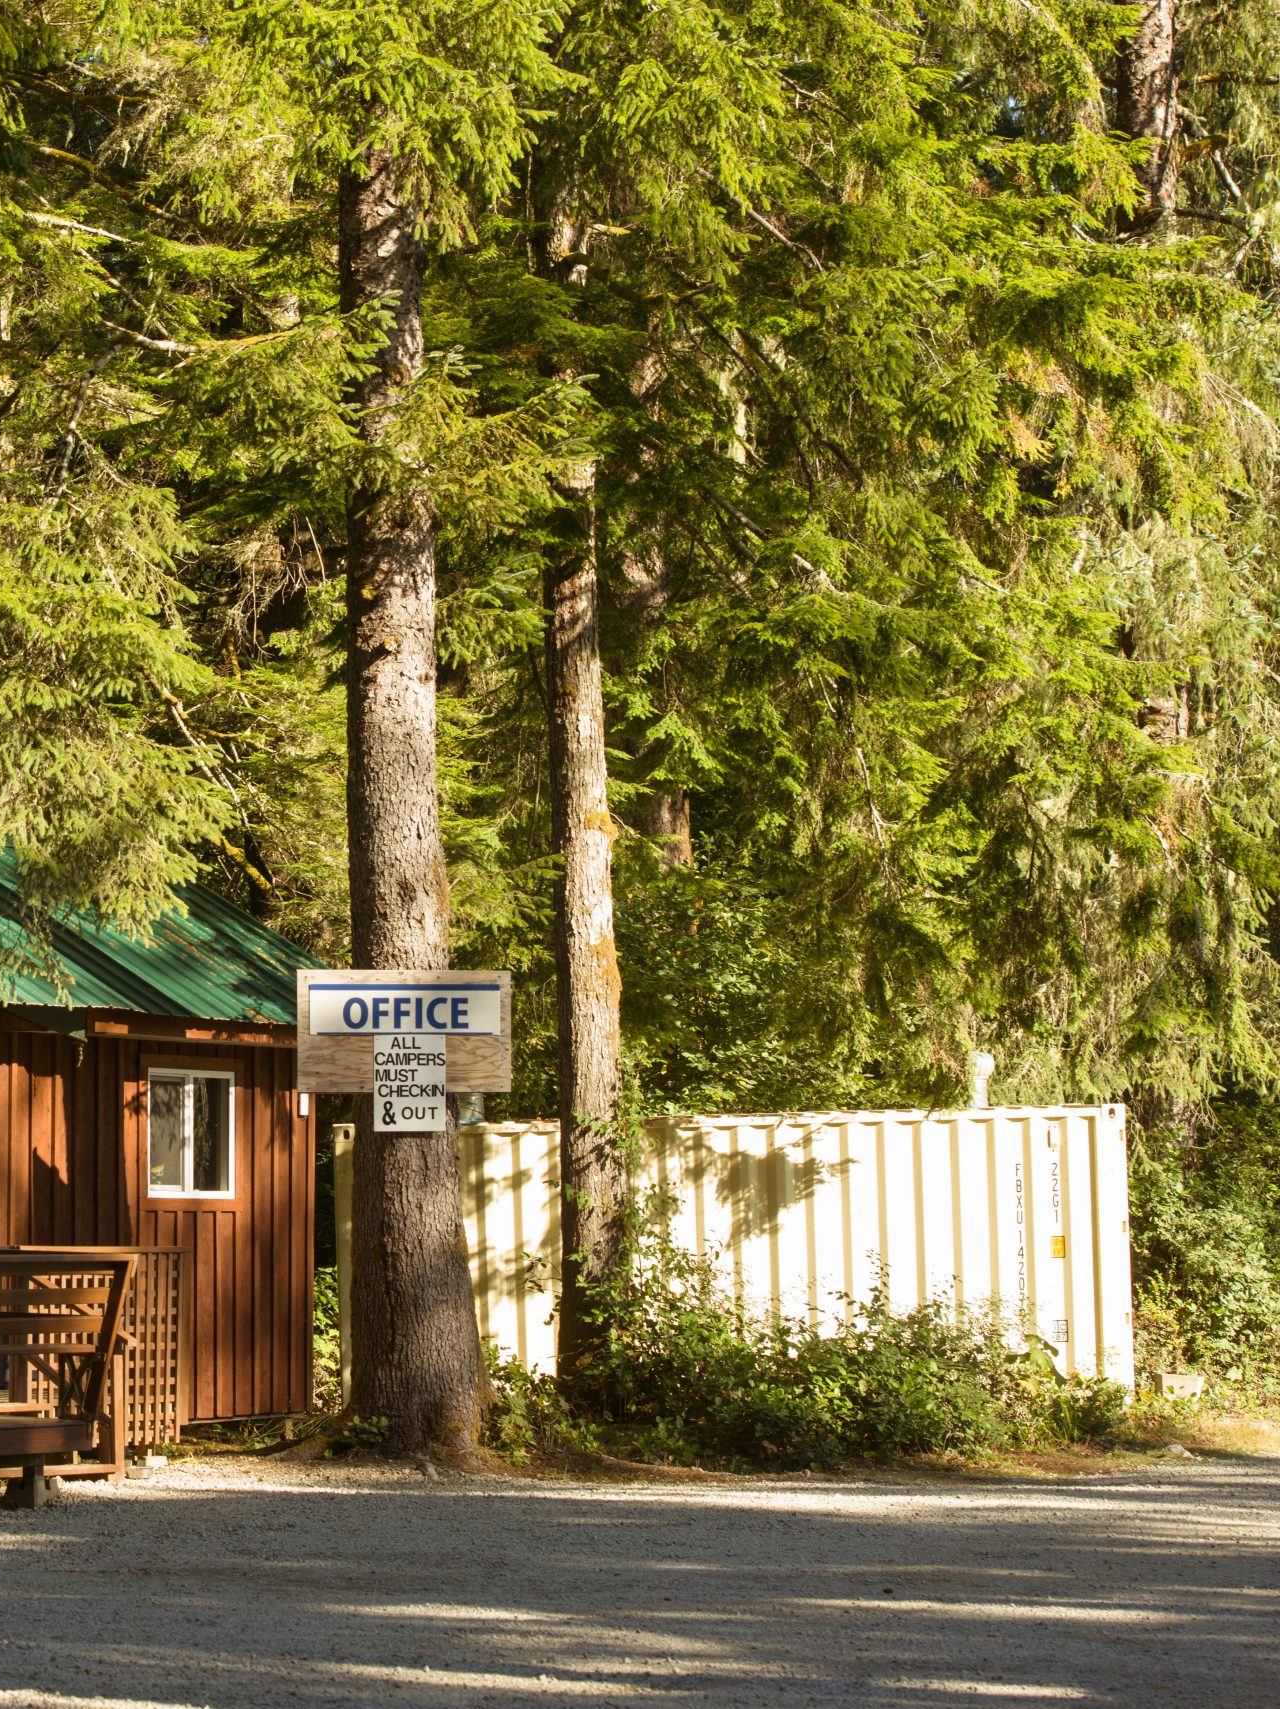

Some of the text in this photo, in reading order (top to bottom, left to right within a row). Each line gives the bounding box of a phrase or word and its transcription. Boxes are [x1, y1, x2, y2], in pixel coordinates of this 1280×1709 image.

[342, 997, 470, 1030] OFFICE
[390, 1036, 422, 1050] ALL
[374, 1052, 446, 1067] CAMPERS
[375, 1069, 418, 1082] MUST
[381, 1100, 439, 1126] & OUT
[1051, 1162, 1059, 1223] 22G1
